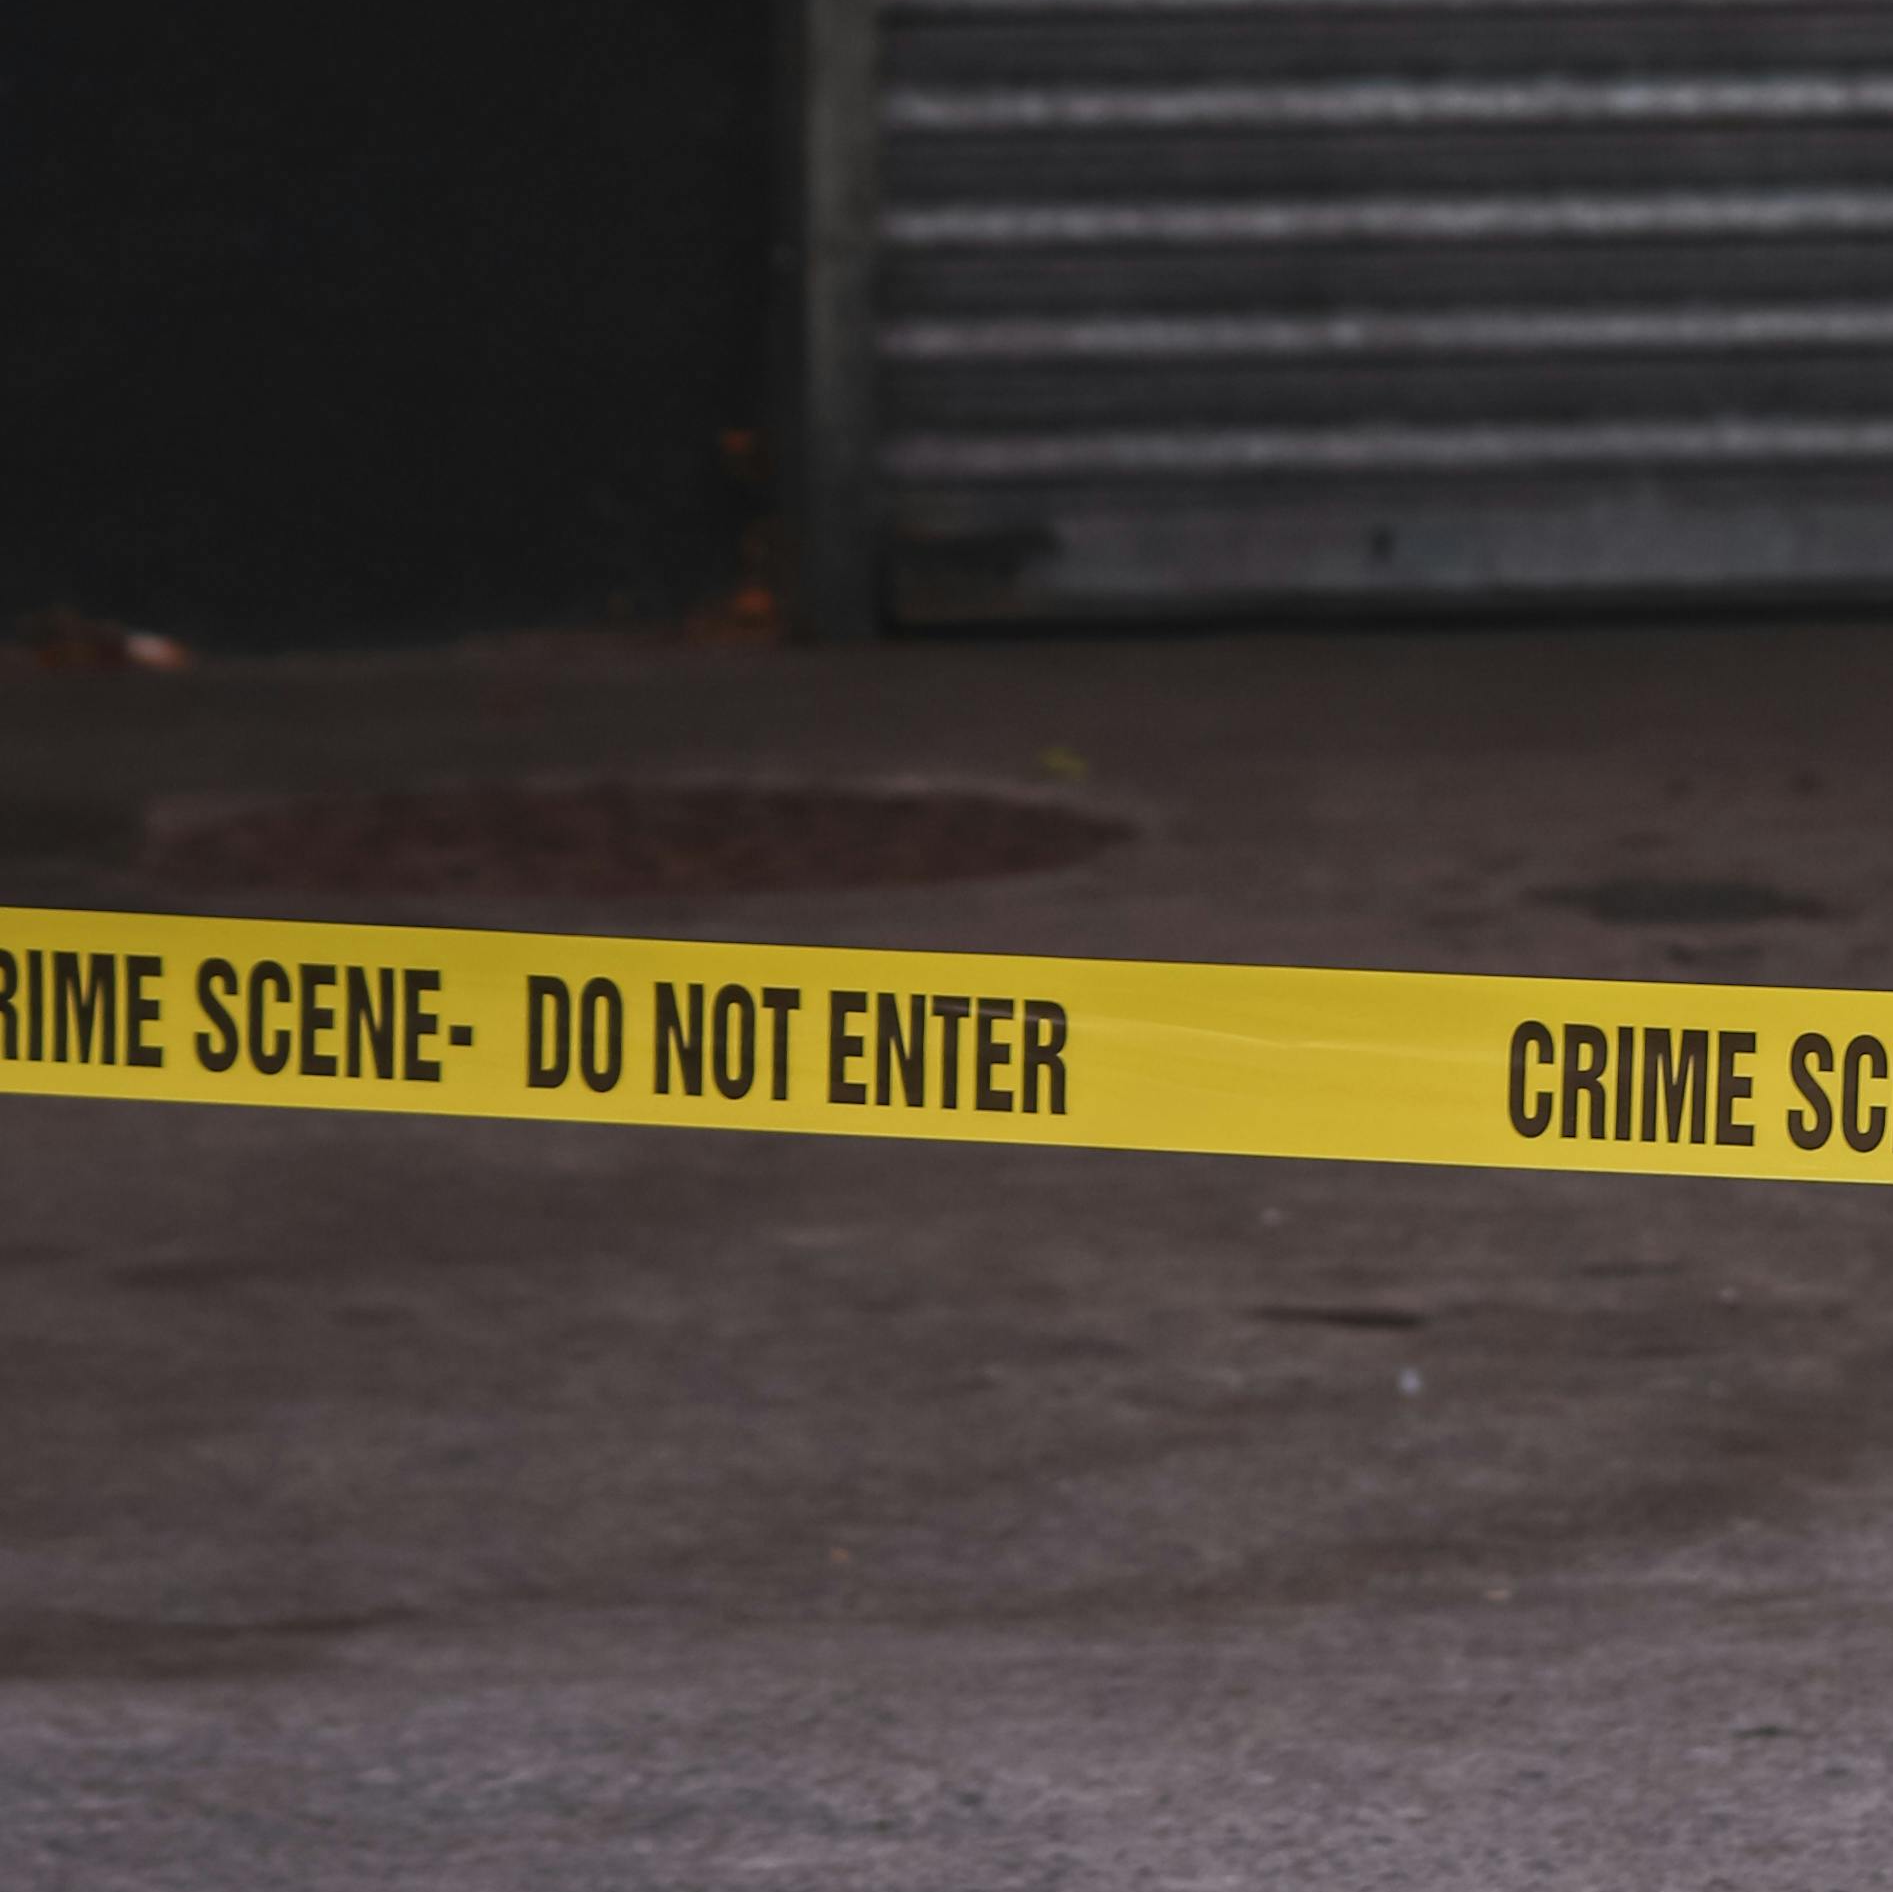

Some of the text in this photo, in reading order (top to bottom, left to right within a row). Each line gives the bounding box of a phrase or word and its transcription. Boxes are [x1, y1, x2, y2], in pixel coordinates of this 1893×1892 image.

[194, 958, 474, 1082] SCENE-
[527, 975, 623, 1093] DO
[654, 983, 800, 1101] NOT
[829, 991, 1067, 1115] ENTER
[1508, 1021, 1756, 1147] CRIME
